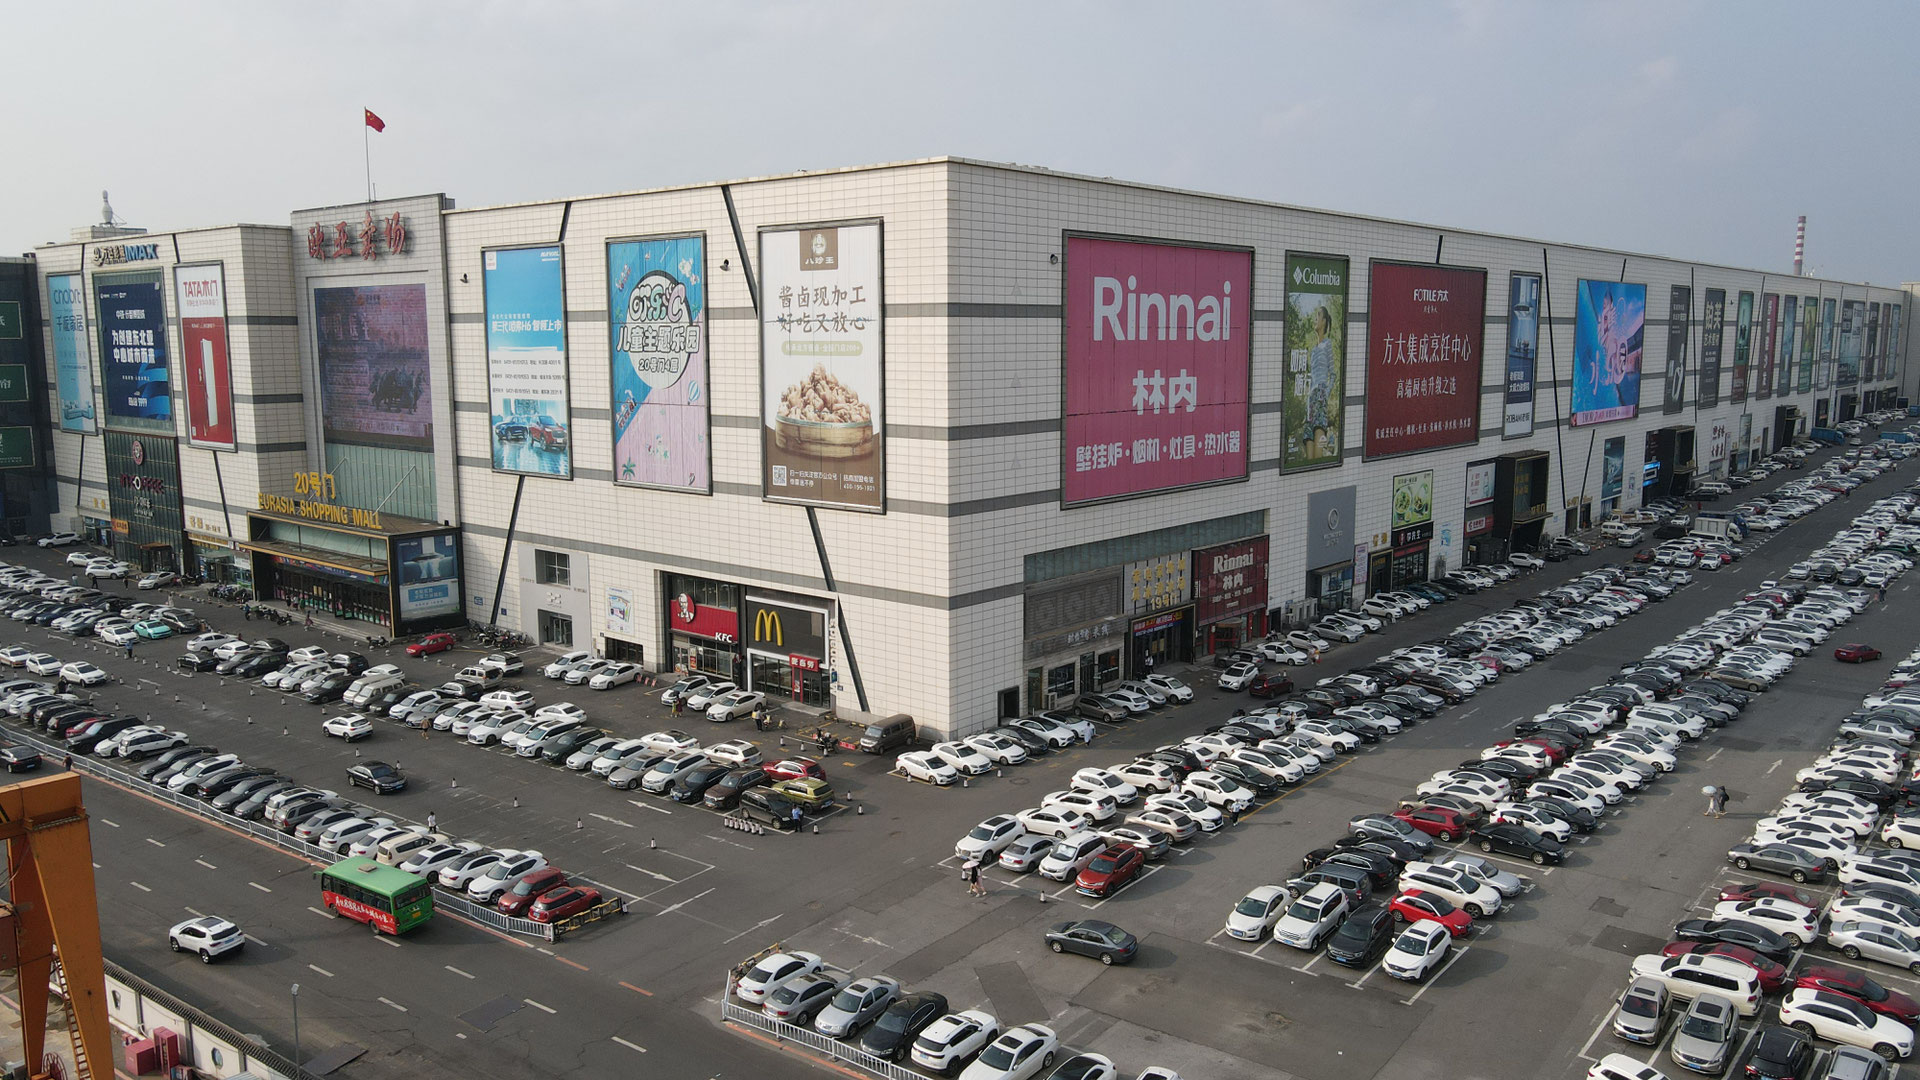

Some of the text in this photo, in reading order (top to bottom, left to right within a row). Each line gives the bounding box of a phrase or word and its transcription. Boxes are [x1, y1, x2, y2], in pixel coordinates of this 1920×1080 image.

[307, 210, 406, 261] 欧亚卖场
[125, 243, 159, 262] IMAX
[1303, 267, 1340, 286] Columbia
[778, 285, 866, 308] 酱卤现加工
[1093, 275, 1231, 342] Rinnai
[777, 312, 866, 333] 好吃又放心
[616, 325, 701, 353] 儿童主题乐园
[1382, 332, 1472, 366] 方太集成烹饪中心
[638, 357, 679, 373] 20号门4层
[1132, 369, 1197, 415] 林内
[1396, 375, 1457, 399] 高端厨电升级之选
[294, 471, 336, 499] 20号门
[258, 492, 383, 530] EURASIA SHOPPING MALL
[1212, 549, 1254, 575] Rinnai
[1222, 572, 1244, 590] 林内
[1150, 593, 1179, 611] 19号门
[714, 632, 733, 644] KFC
[791, 657, 815, 669] 麦当劳
